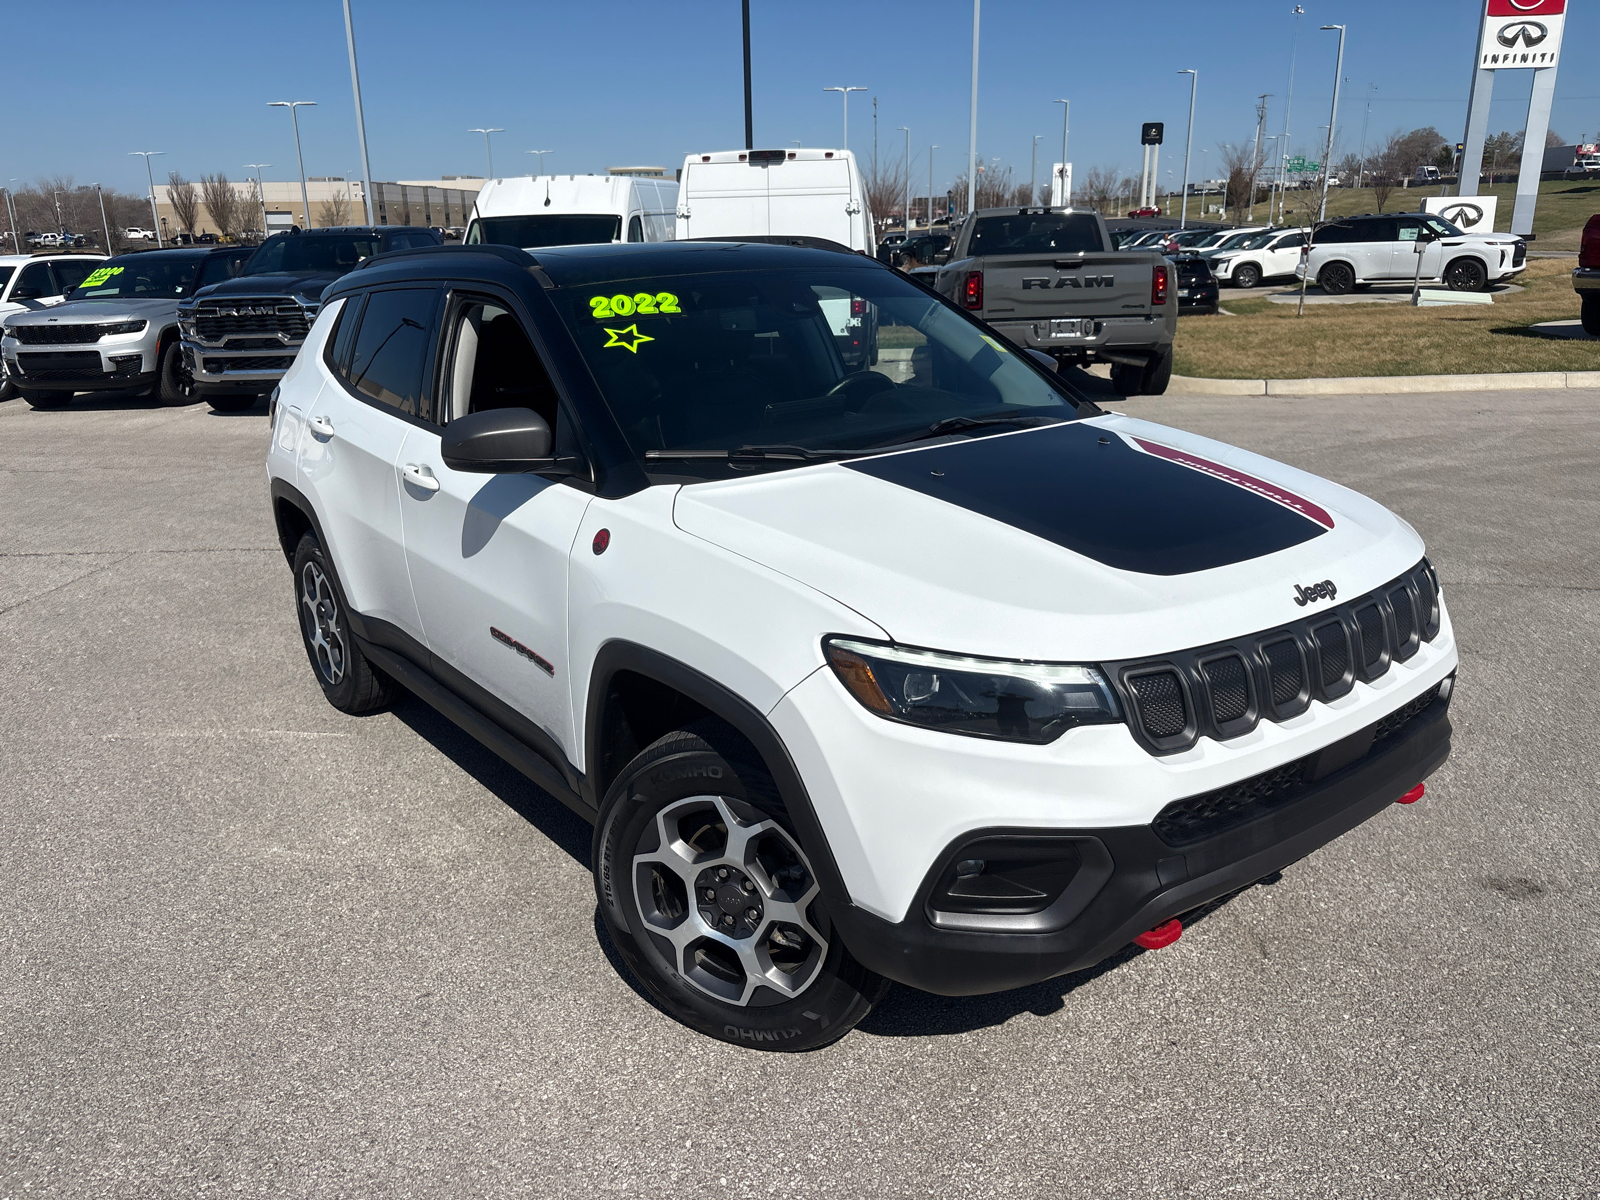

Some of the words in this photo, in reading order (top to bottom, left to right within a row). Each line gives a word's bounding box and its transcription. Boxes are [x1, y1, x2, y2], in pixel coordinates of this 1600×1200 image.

[1483, 52, 1555, 64] INFINITI
[1022, 275, 1115, 290] RAM
[220, 306, 274, 316] RAM
[589, 292, 681, 319] 2022
[1293, 579, 1337, 607] Jeep
[723, 1024, 803, 1042] KUMHO
